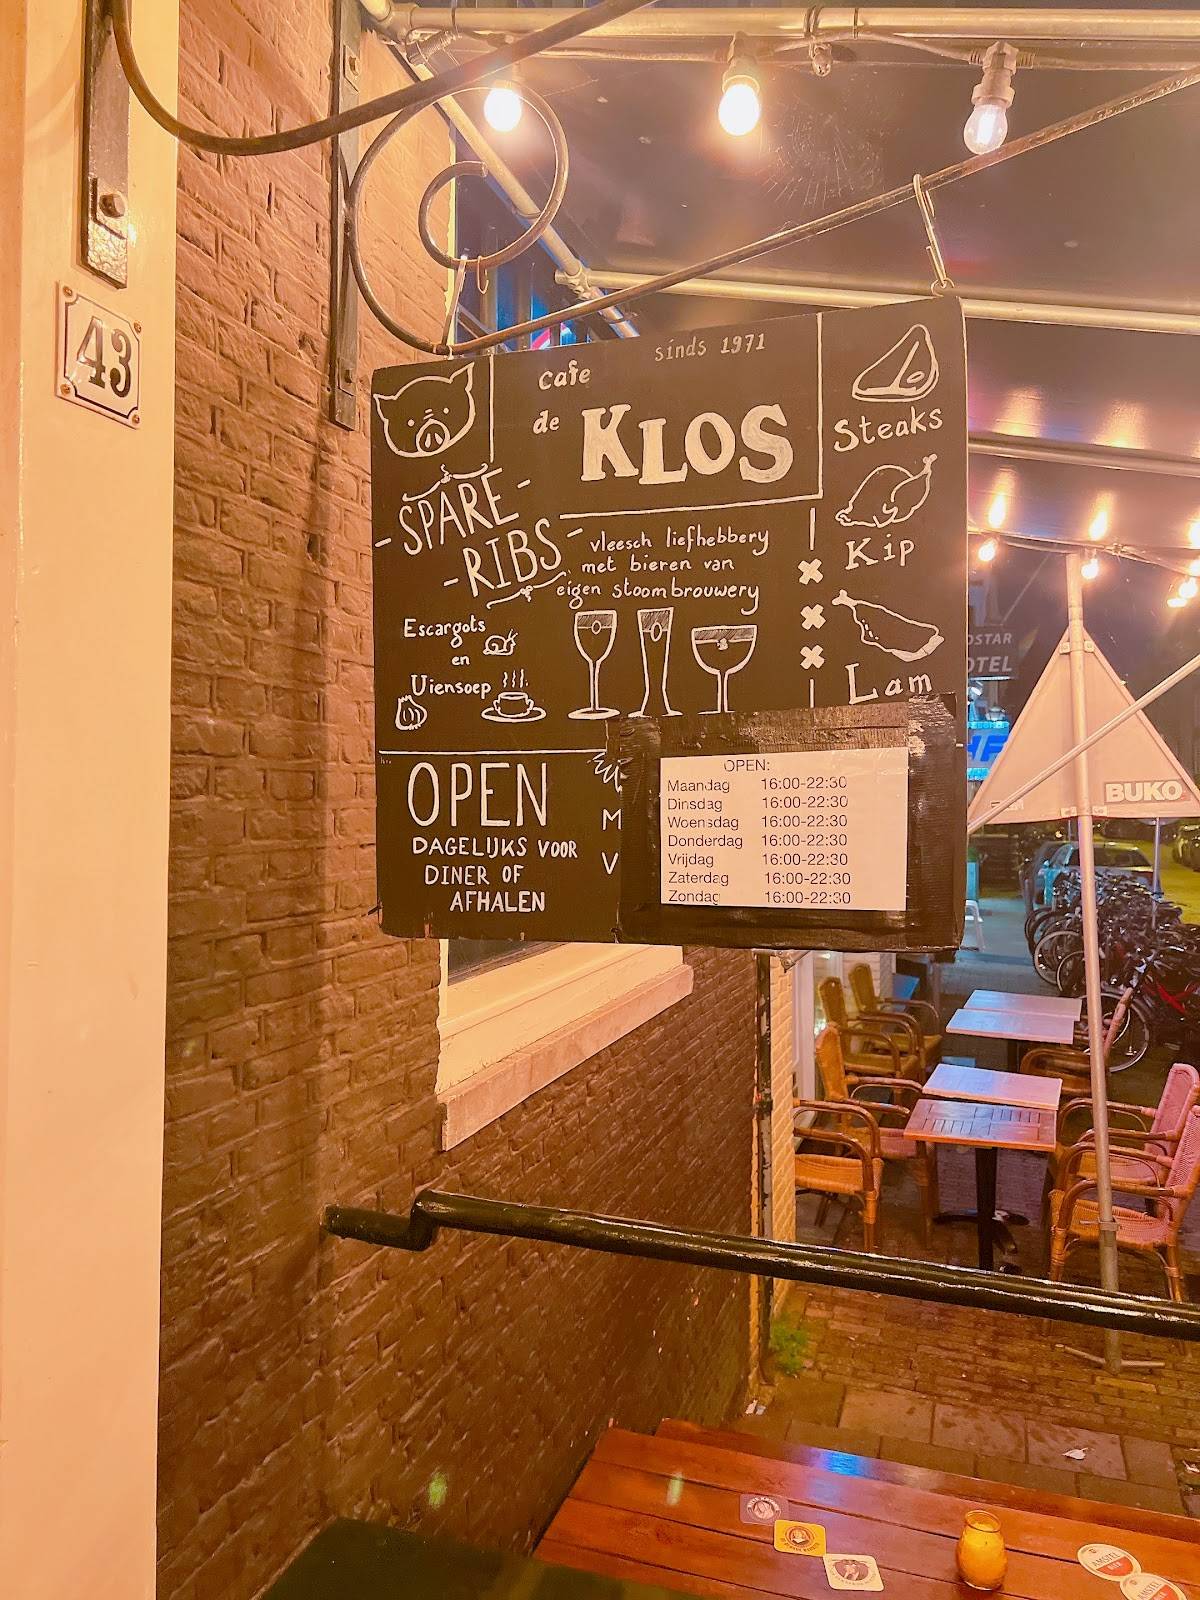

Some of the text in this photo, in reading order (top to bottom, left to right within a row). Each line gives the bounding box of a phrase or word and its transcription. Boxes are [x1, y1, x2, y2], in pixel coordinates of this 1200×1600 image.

[77, 316, 132, 398] 43
[655, 333, 766, 362] sinds 1971
[834, 407, 943, 452] Steaks
[533, 404, 794, 484] de KLOS
[399, 467, 520, 556] SPARE
[590, 524, 769, 556] vleesch liefhebbery
[463, 518, 562, 598] RIBS
[845, 534, 914, 571] Kip
[581, 554, 735, 574] met bieren van
[556, 580, 602, 609] eigen
[404, 614, 486, 649] Escargots
[451, 654, 471, 666] en
[410, 674, 492, 699] Uiensoep
[845, 662, 933, 704] Lam
[723, 758, 771, 773] OPEN:
[407, 761, 548, 827] OPEN
[667, 776, 847, 794] Maandag 16:00-22:30
[1105, 780, 1183, 802] BUKO
[667, 795, 848, 813] Dinsdag 16:00-22:30
[667, 814, 848, 831] Woensdag 16:00-22:30
[538, 839, 578, 859] VOOR
[668, 833, 848, 850] Donderdag 16:00-22:30
[668, 853, 849, 868] Vrijdag 16:00-22:30
[424, 864, 524, 886] DINER OF
[668, 871, 851, 887] Zaterdag 16:00-22:30
[449, 890, 546, 913] AFHALEN
[668, 890, 851, 906] Zondag 16:00-22:30
[1093, 1552, 1120, 1567] AMSTEL
